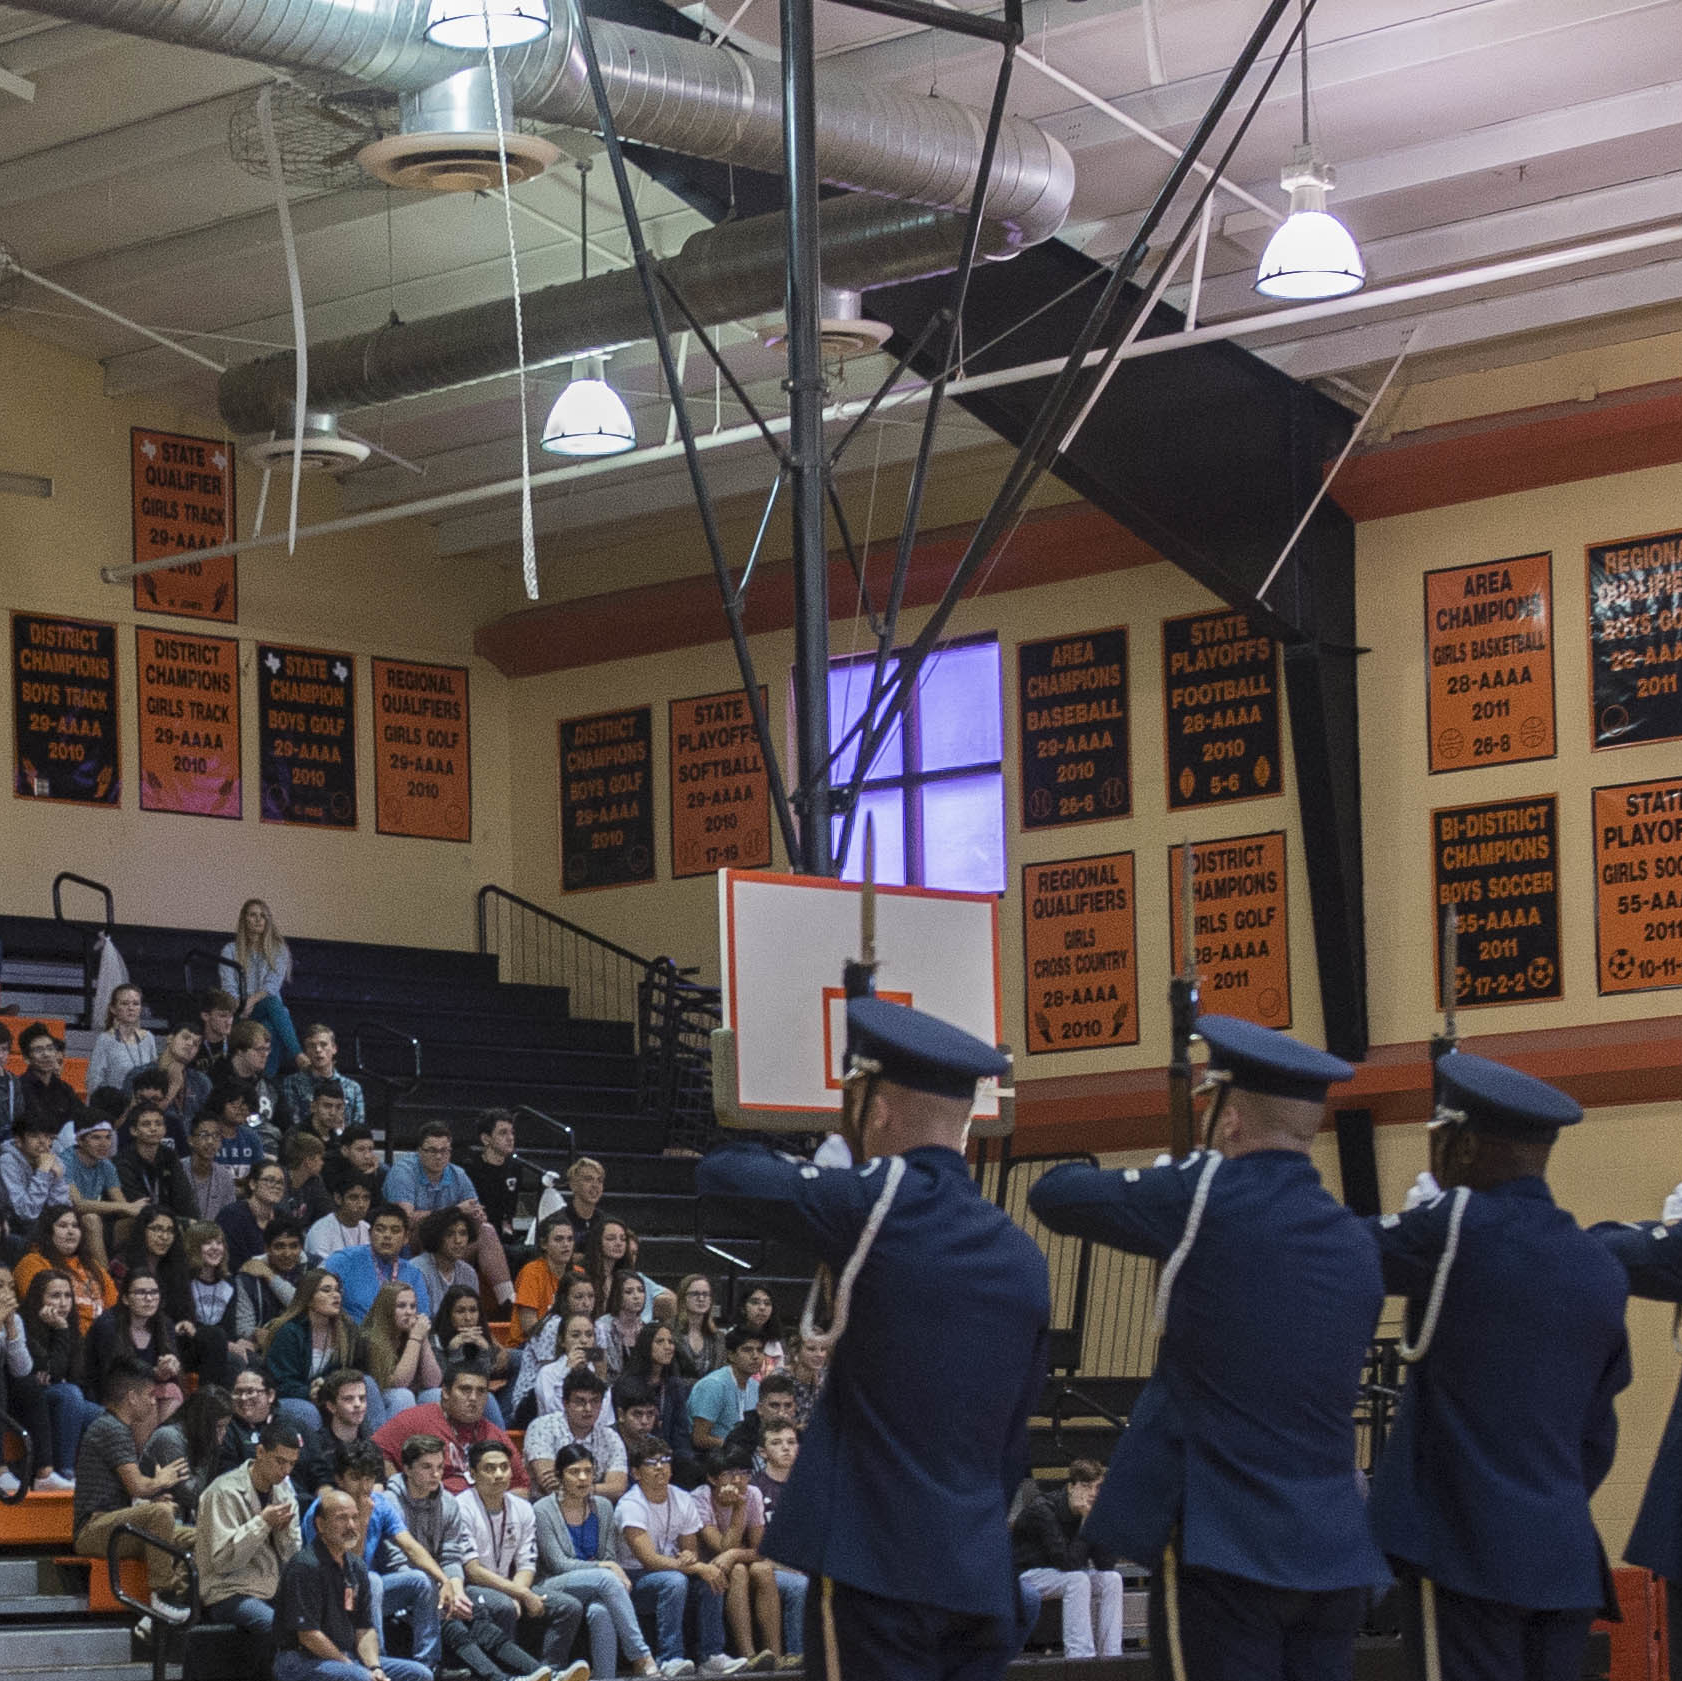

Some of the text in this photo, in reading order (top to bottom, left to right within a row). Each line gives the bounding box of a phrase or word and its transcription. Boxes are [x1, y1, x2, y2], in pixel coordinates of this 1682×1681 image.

[1464, 570, 1512, 598] AREA
[1436, 594, 1541, 631] CHAMPIONS
[1191, 615, 1249, 644] STATE
[1172, 639, 1269, 675] PLAYOFFS
[1434, 632, 1545, 667] GIRLS BASKETBALL
[387, 669, 455, 695] REGIONAL
[1172, 675, 1270, 709] FOOTBALL
[1448, 666, 1532, 695] 28-AAAA
[382, 696, 460, 719] QUALIFIERS
[1183, 705, 1261, 734] 28-AAAA
[1472, 700, 1510, 721] 2011
[384, 726, 458, 749] GIRLS GOLF
[1203, 739, 1245, 761] 2010
[390, 754, 455, 775] 29-AAAA
[407, 782, 439, 799] 2010
[1442, 806, 1548, 840] BI-DISTRICT
[1443, 835, 1549, 870] CHAMPIONS
[1603, 860, 1647, 885] GIRLS
[1441, 872, 1553, 904] BOYS SOCCER
[1456, 907, 1541, 934] 55-AAAA
[1645, 920, 1682, 942] 2011
[1479, 938, 1518, 961] 2011
[1474, 973, 1525, 996] 17-2-2
